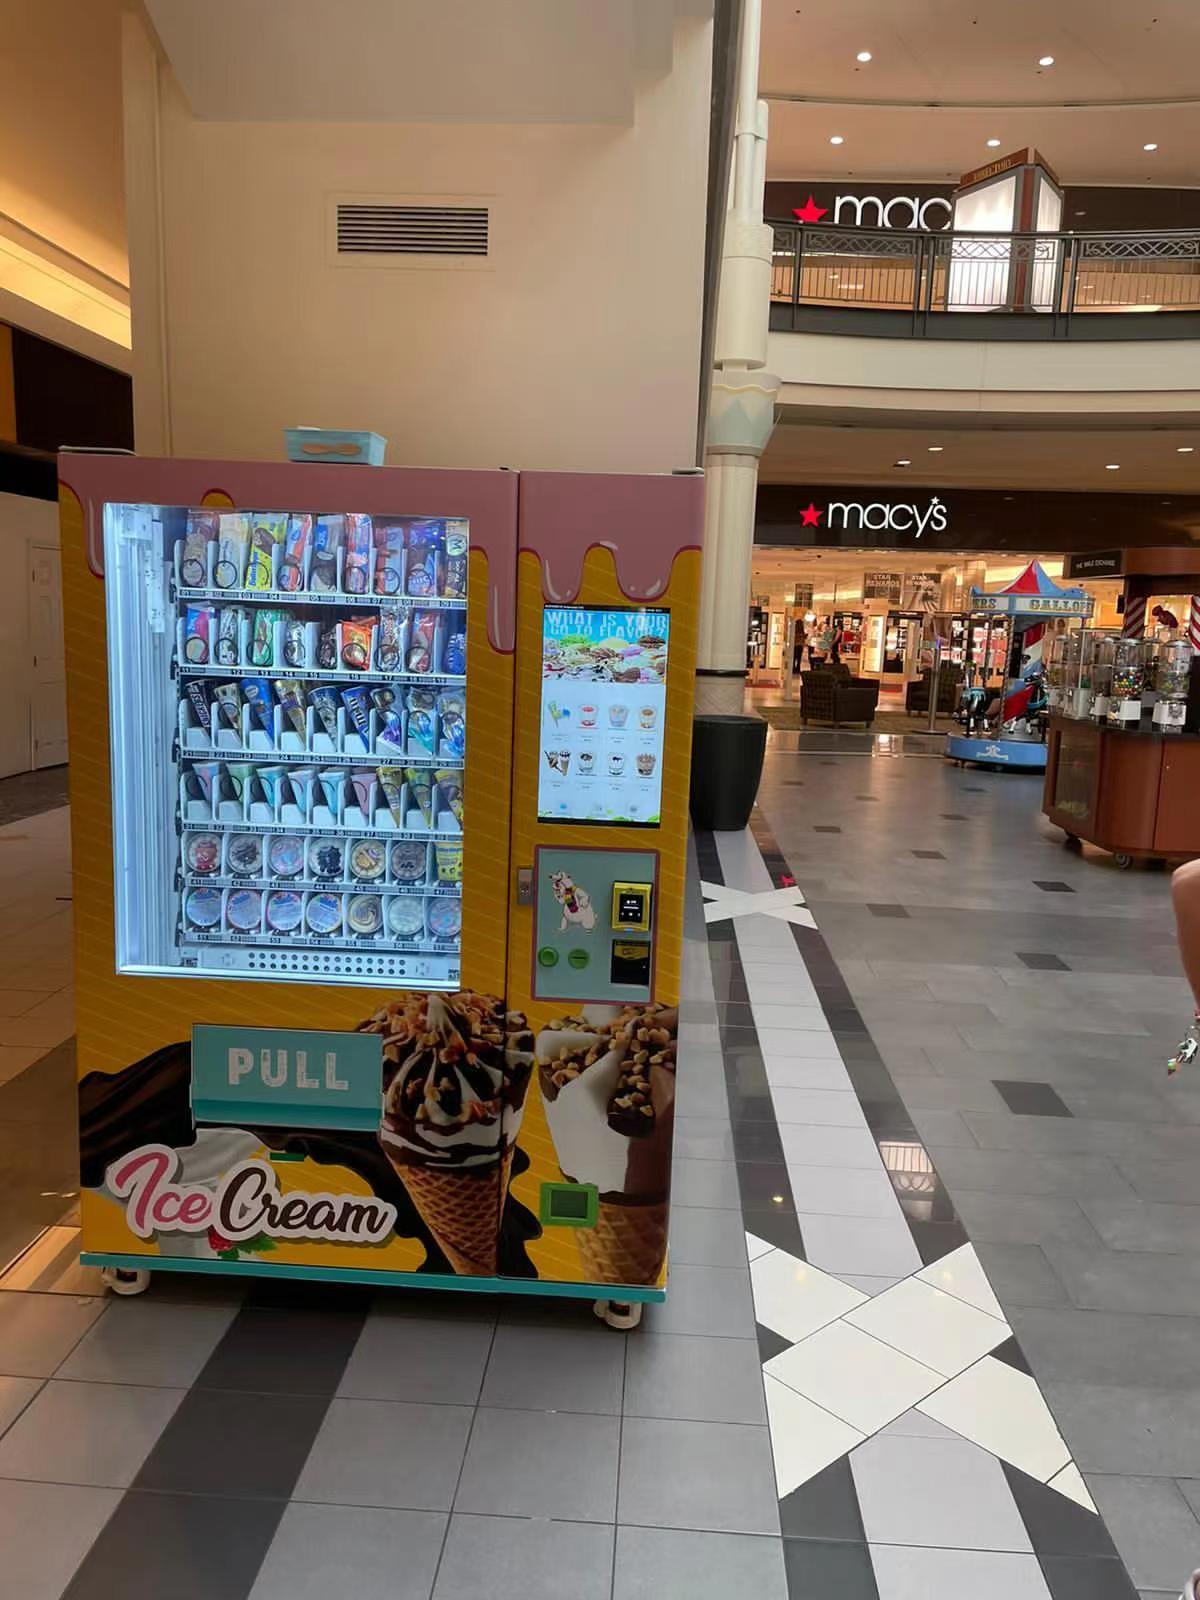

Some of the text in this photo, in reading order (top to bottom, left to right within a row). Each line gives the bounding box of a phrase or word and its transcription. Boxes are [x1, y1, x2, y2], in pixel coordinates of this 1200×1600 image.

[834, 195, 953, 232] mac
[827, 496, 948, 538] macy's
[546, 611, 667, 629] WHAT IS YOUR
[550, 624, 569, 635] GO
[576, 624, 593, 635] TO
[228, 1047, 349, 1091] PULL
[115, 1151, 388, 1234] Ice Cream
